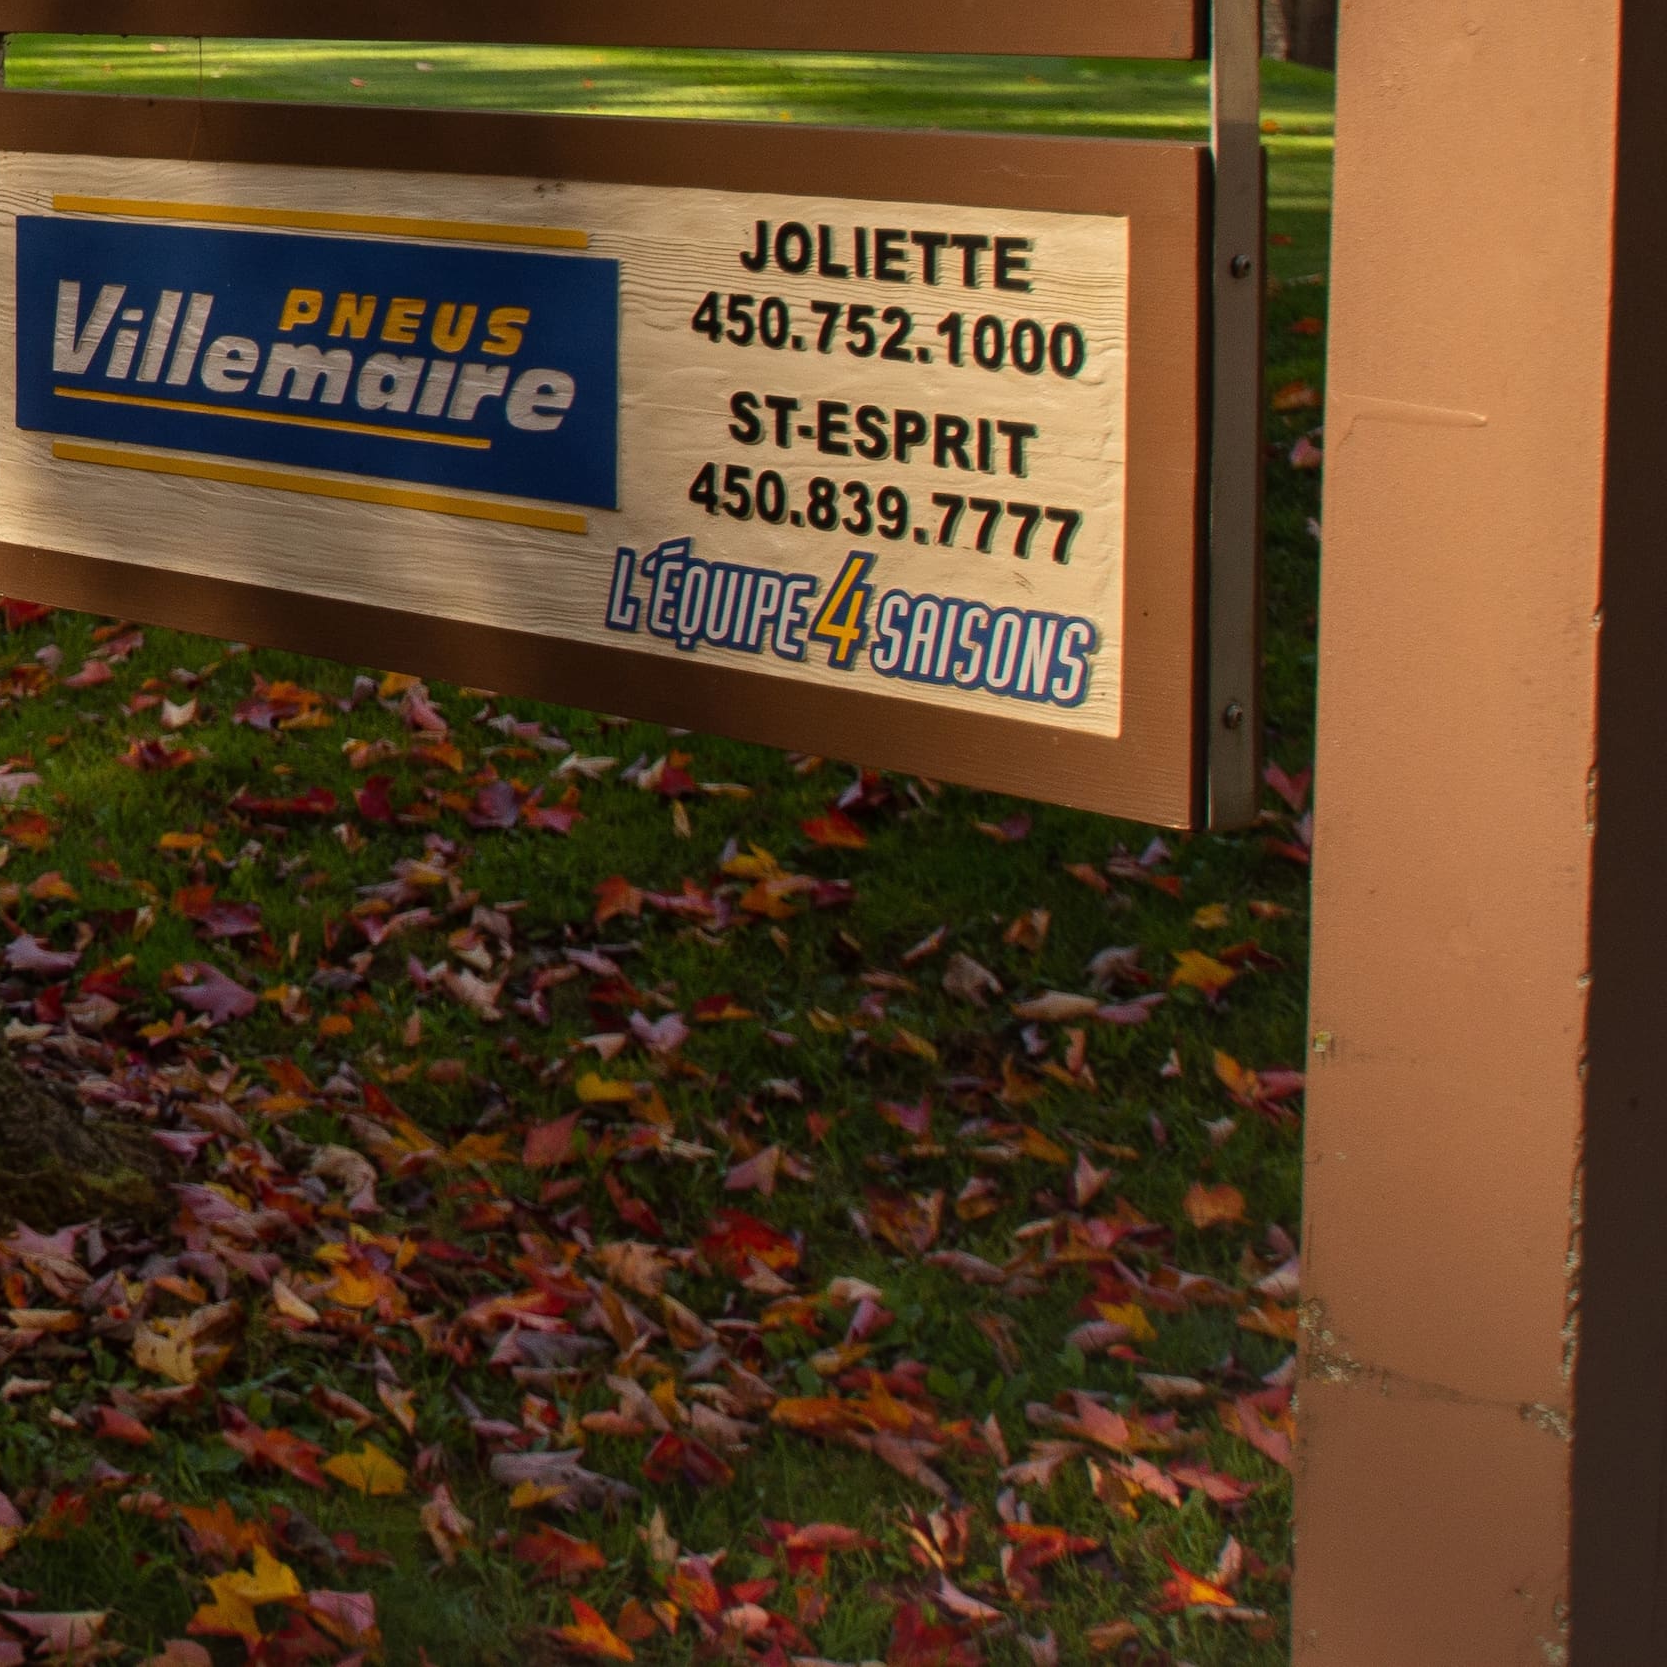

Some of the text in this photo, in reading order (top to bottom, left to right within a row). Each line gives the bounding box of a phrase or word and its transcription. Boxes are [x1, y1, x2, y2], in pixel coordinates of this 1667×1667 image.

[740, 219, 1036, 292] JOLIETTE
[52, 278, 576, 432] Villemaire
[279, 289, 531, 357] PNEUS
[691, 290, 1085, 378] 450.752.1000
[728, 390, 1038, 477] ST-ESPRIT
[688, 463, 1083, 564] 450.839.7777
[609, 541, 1092, 702] L'ÉQUIPE 4 SAISONS
